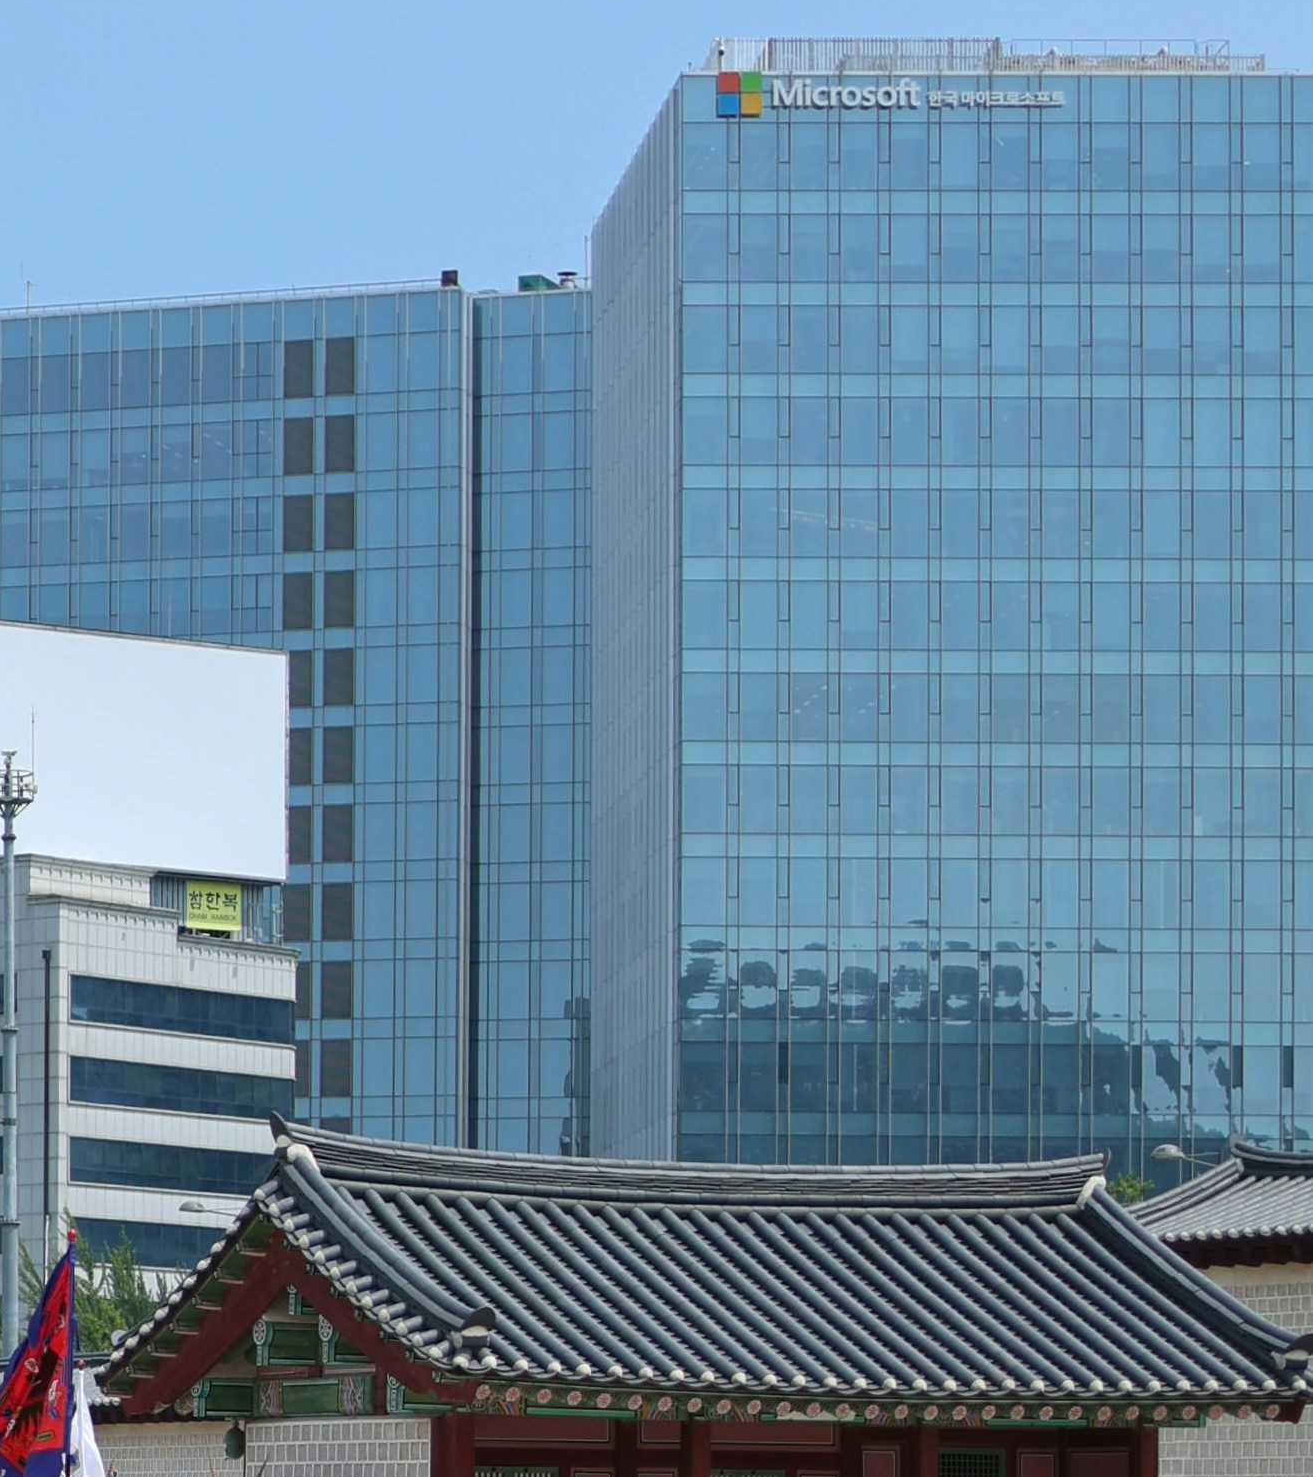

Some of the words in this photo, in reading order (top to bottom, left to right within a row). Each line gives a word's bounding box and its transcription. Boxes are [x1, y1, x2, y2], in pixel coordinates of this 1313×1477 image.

[772, 77, 921, 107] Microsoft
[927, 90, 958, 107] 한국
[961, 90, 1066, 106] 마이크로소프트
[189, 890, 238, 912] 참한복
